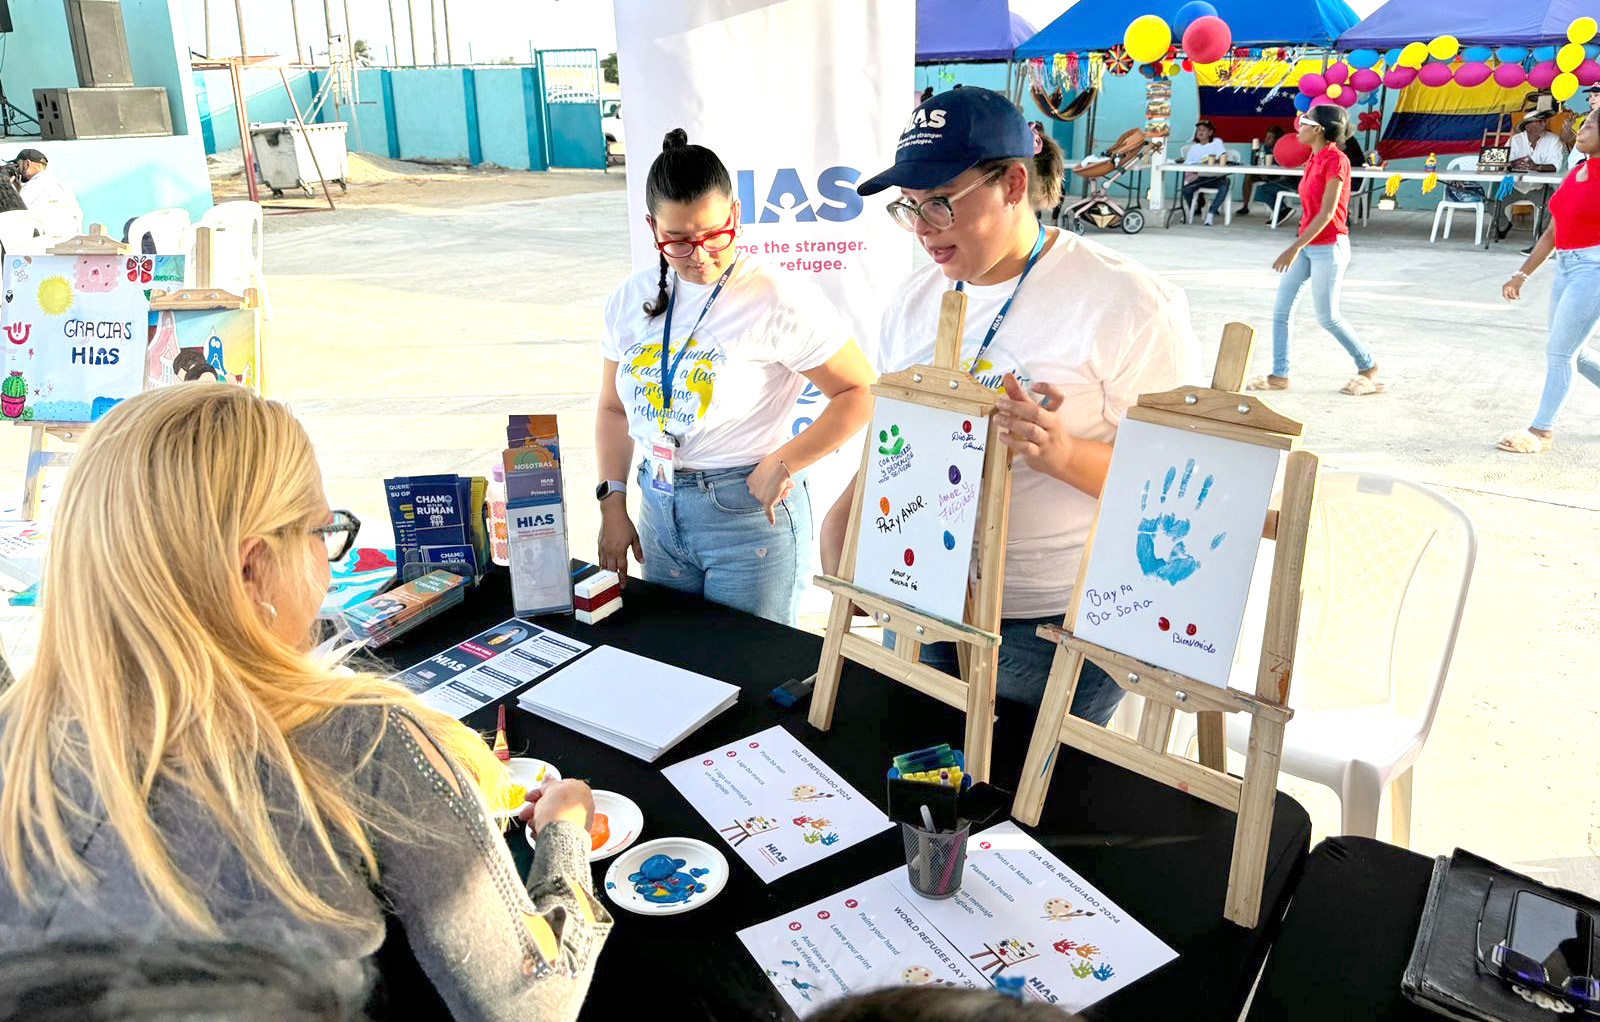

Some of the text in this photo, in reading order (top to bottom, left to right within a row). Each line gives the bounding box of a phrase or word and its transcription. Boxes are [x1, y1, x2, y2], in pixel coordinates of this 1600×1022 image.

[736, 166, 864, 224] IAS
[764, 241, 790, 254] the
[795, 240, 868, 254] stranger.
[64, 319, 132, 340] GRACIAS
[72, 346, 120, 366] HIAS
[692, 367, 717, 384] las
[634, 384, 693, 403] persnas
[514, 461, 553, 470] NOSOTRAS
[416, 506, 454, 514] RUMAN
[516, 514, 555, 528] HIAS
[1120, 584, 1134, 596] pa
[430, 654, 467, 672] HIAS
[792, 749, 802, 758] DIA
[807, 762, 838, 788] REFUGIADO
[836, 788, 852, 800] 2024
[765, 843, 787, 862] HIAS
[994, 852, 1010, 866] Pinta
[1015, 870, 1032, 885] Mano
[969, 863, 990, 881] Plasma
[996, 886, 1014, 902] huella
[1028, 850, 1120, 924] DIA DEL REFUGIADO 2024
[952, 894, 974, 915] fugiado
[961, 890, 994, 918] un mensaje
[859, 912, 874, 928] Paint
[870, 926, 886, 940] your
[884, 940, 901, 956] hand
[791, 939, 798, 947] to
[800, 950, 821, 974] refugee
[830, 924, 846, 941] Leave
[843, 940, 858, 955] your
[855, 954, 873, 970] print
[894, 906, 977, 990] WORLD REFUGEE DAY 20
[802, 936, 815, 948] And
[812, 947, 827, 964] leave
[828, 968, 850, 993] messag
[1028, 976, 1059, 1004] HIAS
